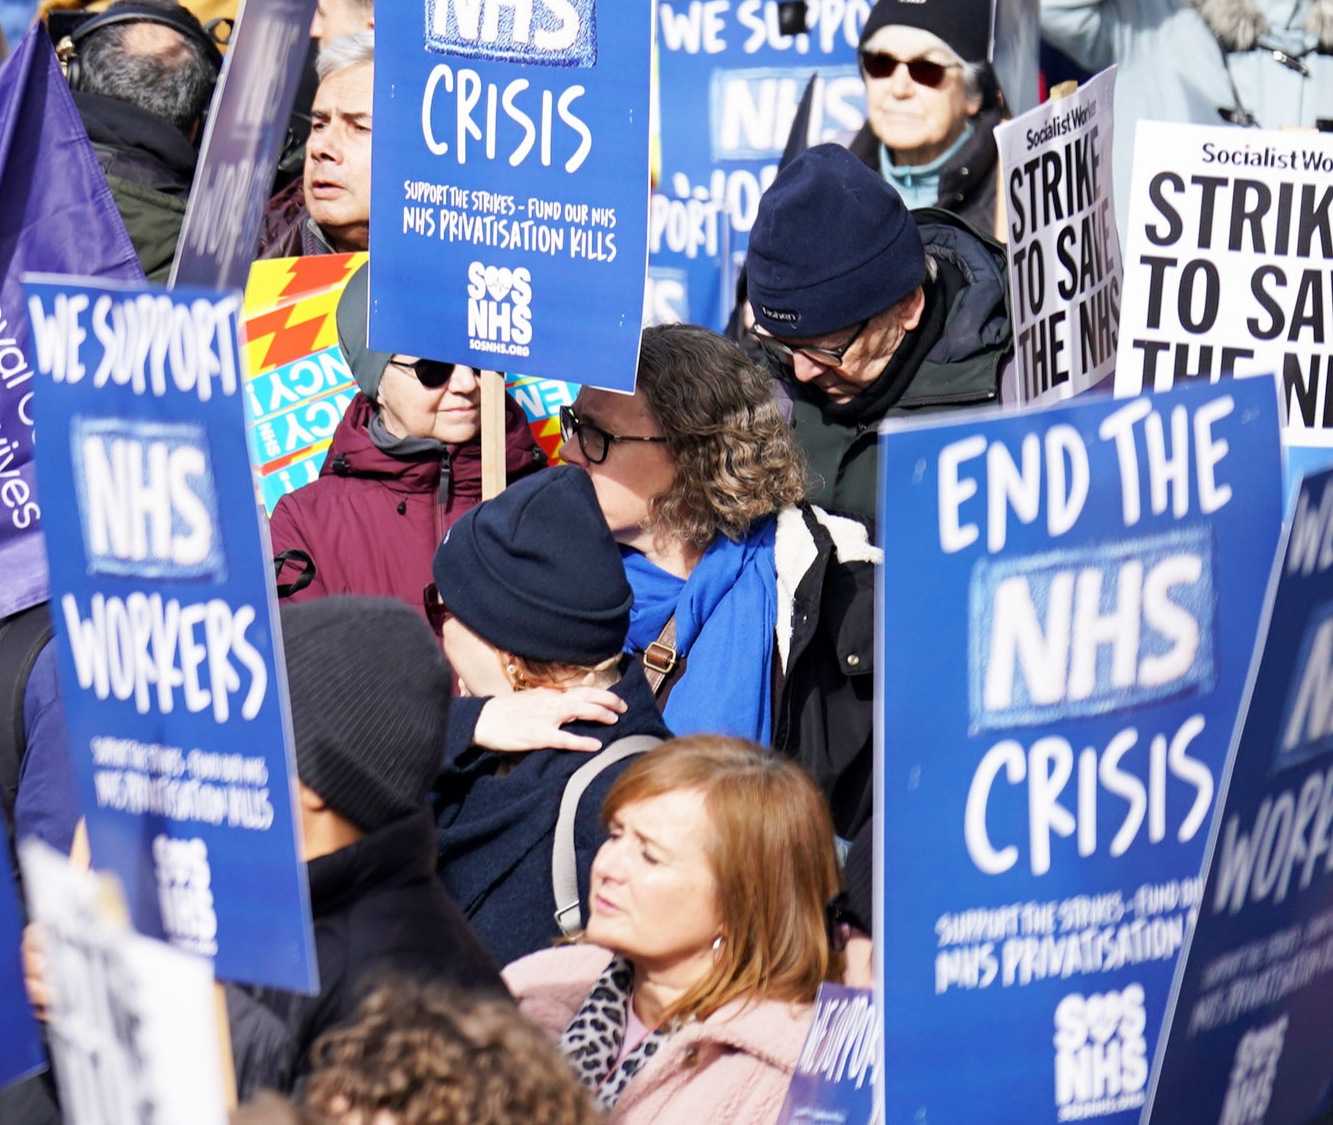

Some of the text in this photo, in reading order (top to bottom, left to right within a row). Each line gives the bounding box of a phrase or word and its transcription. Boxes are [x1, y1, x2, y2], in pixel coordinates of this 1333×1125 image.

[421, 63, 593, 174] CRISIS
[1026, 112, 1072, 151] Socialist
[1201, 142, 1299, 171] Socialist
[403, 179, 617, 229] SUPPORT THE STRIKES FUND OUR NHS
[1009, 126, 1103, 244] STRIKE
[1144, 171, 1333, 261] STRIK
[403, 206, 618, 263] NHS PRIVATISATION KILLS
[1013, 198, 1115, 325] TO SAVE
[467, 297, 533, 345] NHS
[1139, 255, 1221, 335] TO
[29, 293, 237, 403] WE SUPPORT
[469, 338, 531, 358] SOSNHS.ORG
[1018, 311, 1070, 405] THE
[83, 434, 211, 565] NHS
[938, 394, 1235, 554] END THE
[61, 591, 268, 723] WORKERS
[981, 551, 1203, 712] NHS
[963, 713, 1215, 877] CRISIS
[1054, 1035, 1149, 1107] NHS
